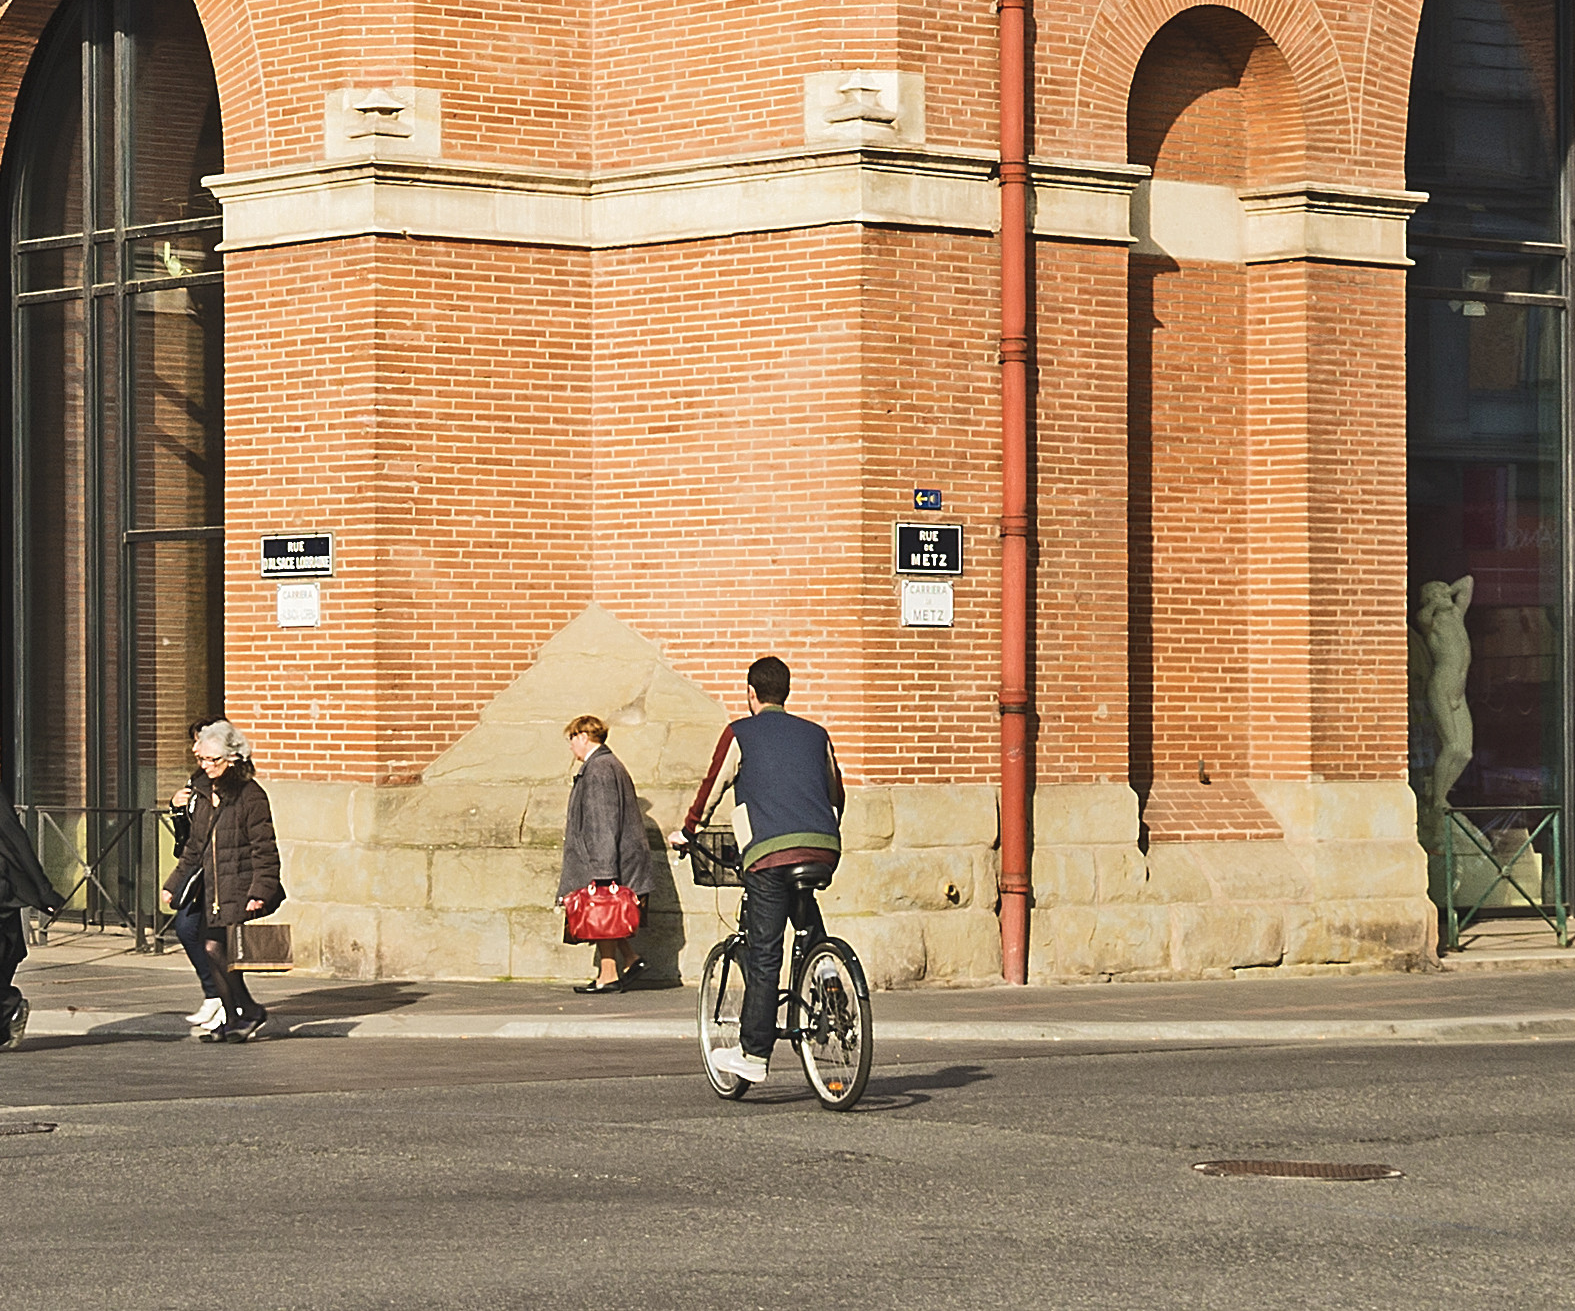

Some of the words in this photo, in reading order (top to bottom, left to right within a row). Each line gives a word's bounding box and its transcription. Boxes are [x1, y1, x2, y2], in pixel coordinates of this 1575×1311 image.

[919, 530, 939, 542] RUE
[287, 541, 305, 553] RUE
[911, 553, 948, 567] METZ
[909, 584, 948, 595] CARRIERA
[913, 609, 944, 622] METZ
